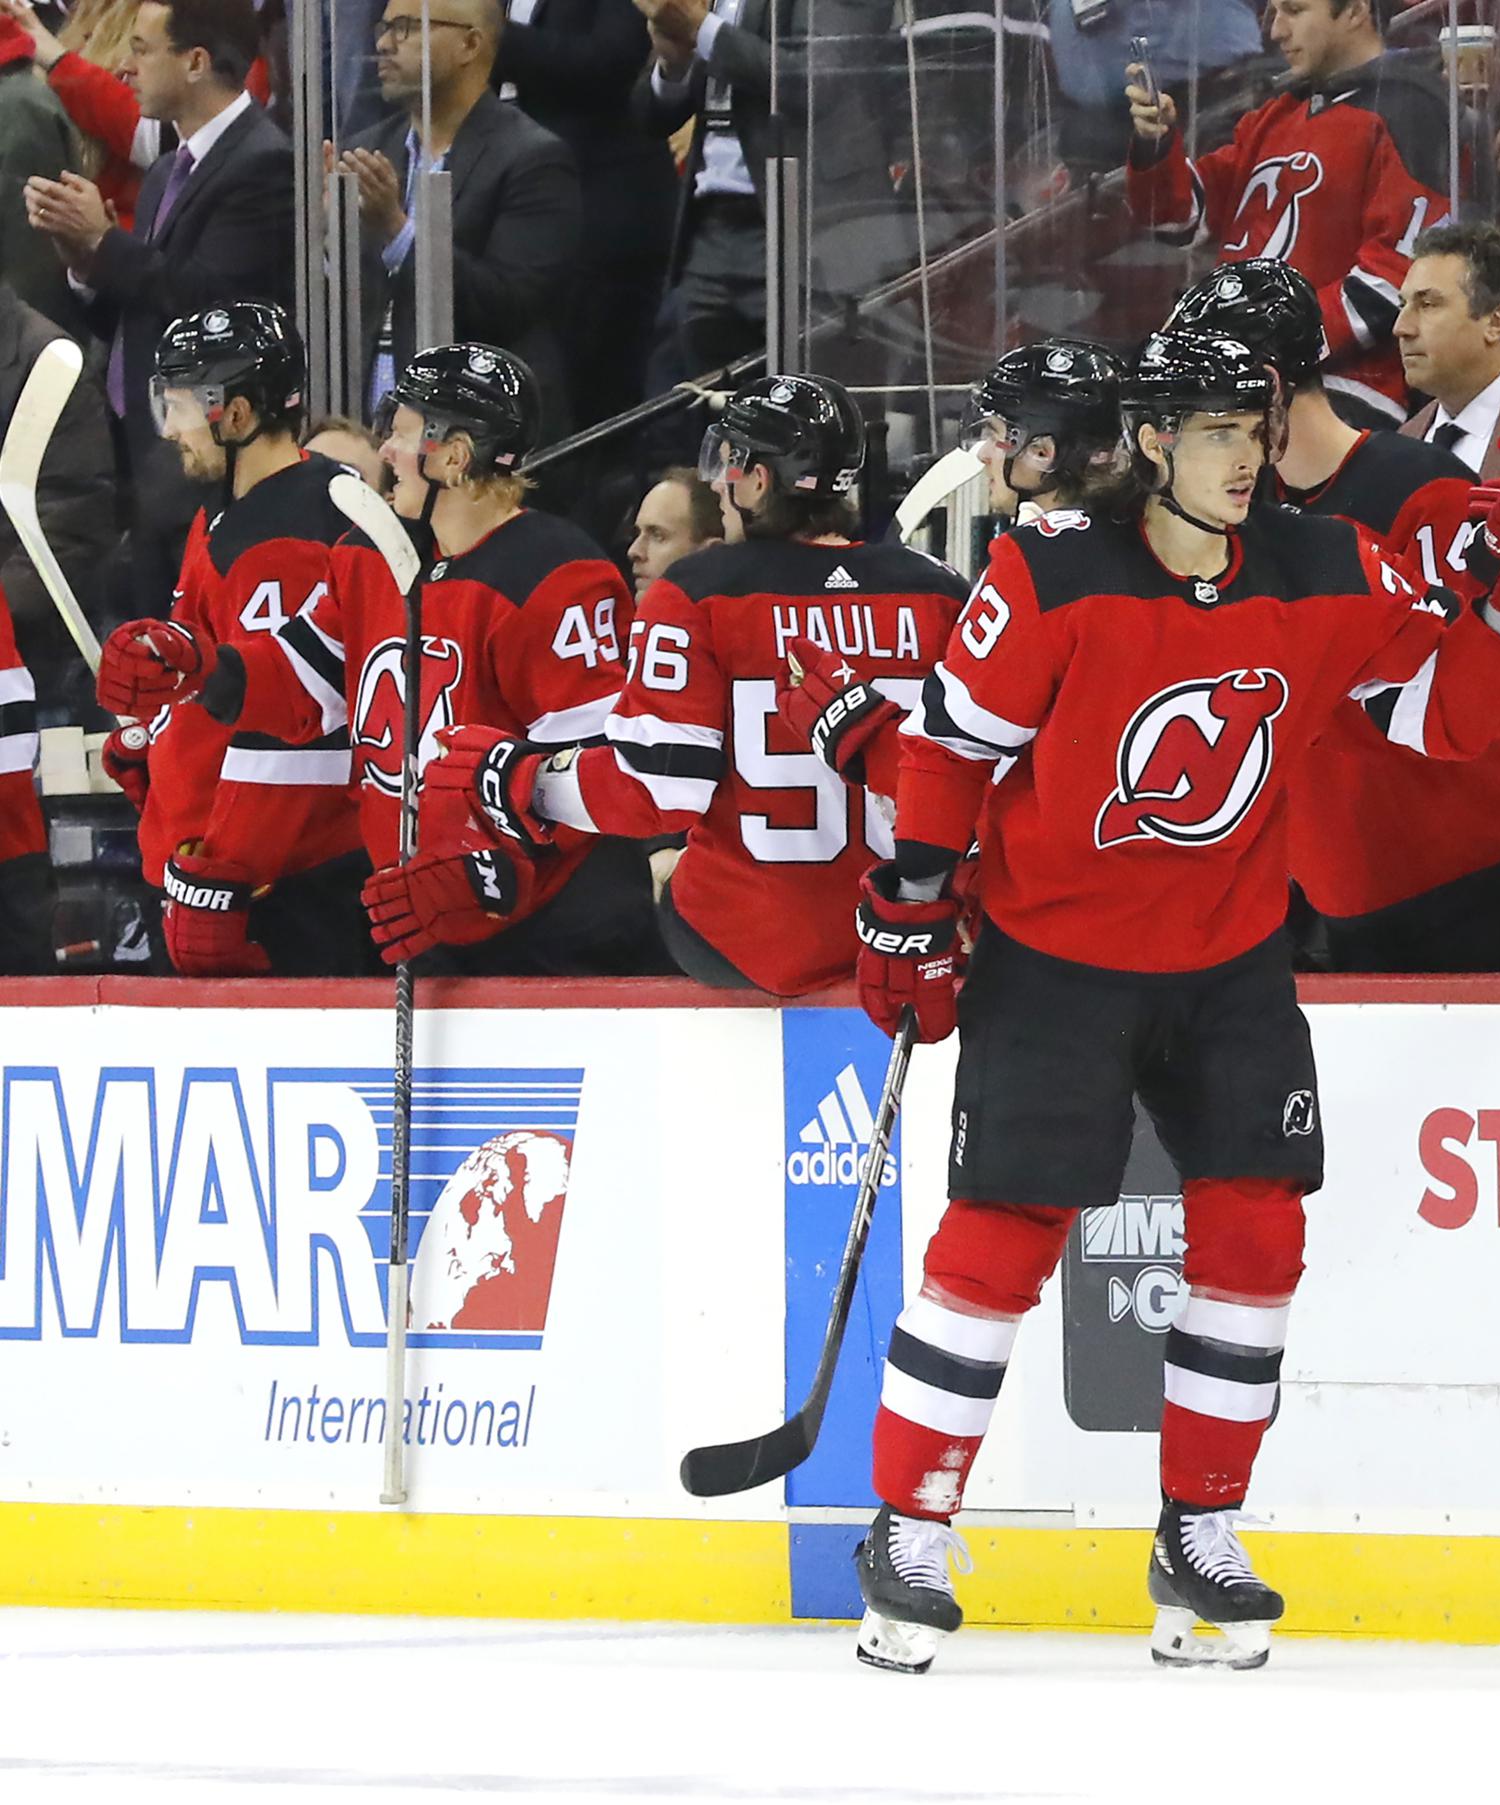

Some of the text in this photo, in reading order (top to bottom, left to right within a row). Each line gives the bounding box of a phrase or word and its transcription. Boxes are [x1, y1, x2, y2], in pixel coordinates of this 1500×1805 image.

[551, 597, 621, 669] 49
[773, 603, 920, 661] HAULA
[0, 1065, 390, 1348] MAR
[264, 1380, 536, 1448] International
